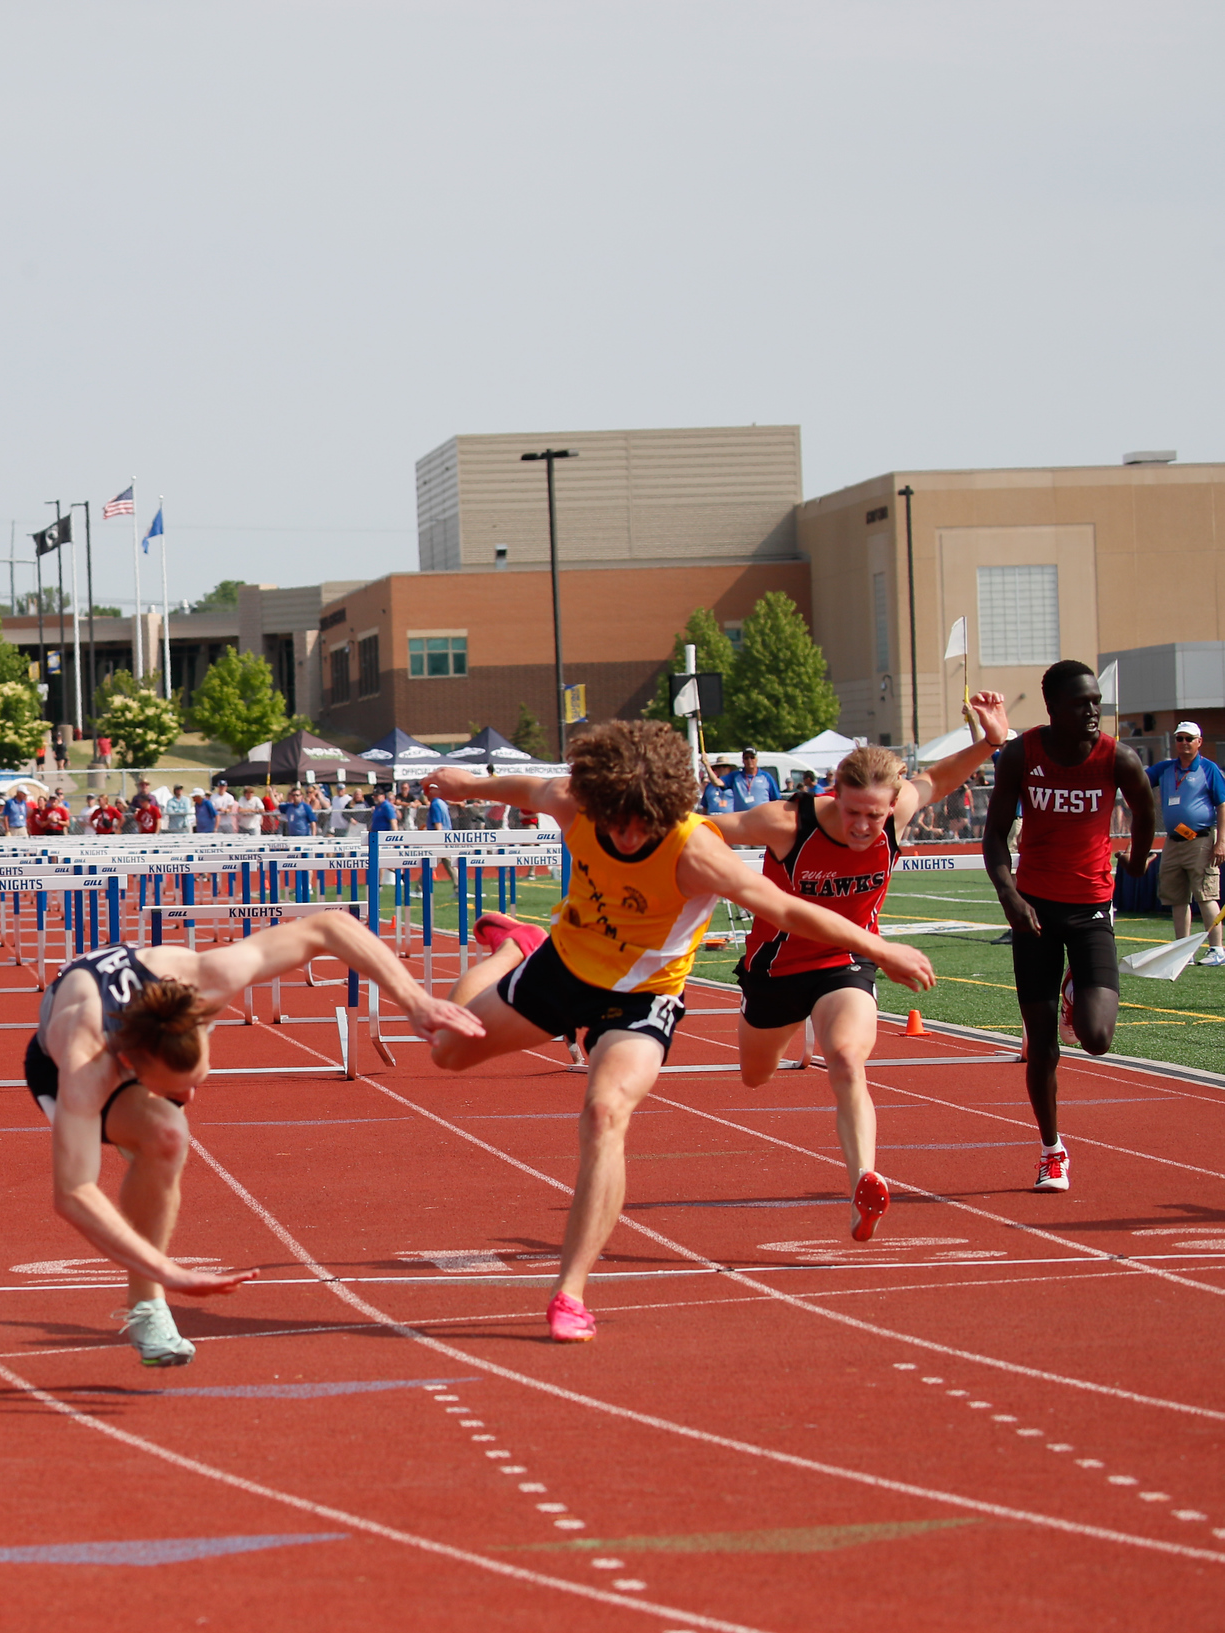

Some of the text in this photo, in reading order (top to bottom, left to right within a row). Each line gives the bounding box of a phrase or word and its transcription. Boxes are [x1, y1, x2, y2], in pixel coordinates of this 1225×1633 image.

[1027, 786, 1103, 814] WEST
[444, 832, 497, 843] KNIGHTS
[329, 859, 369, 869] KNIGHTS
[516, 856, 558, 866] KNIGHTS
[902, 858, 955, 870] KNIGHTS
[149, 863, 191, 874] KNIGHTS
[801, 870, 838, 880] White
[798, 871, 885, 897] HAWKS
[228, 907, 283, 918] KNIGHTS
